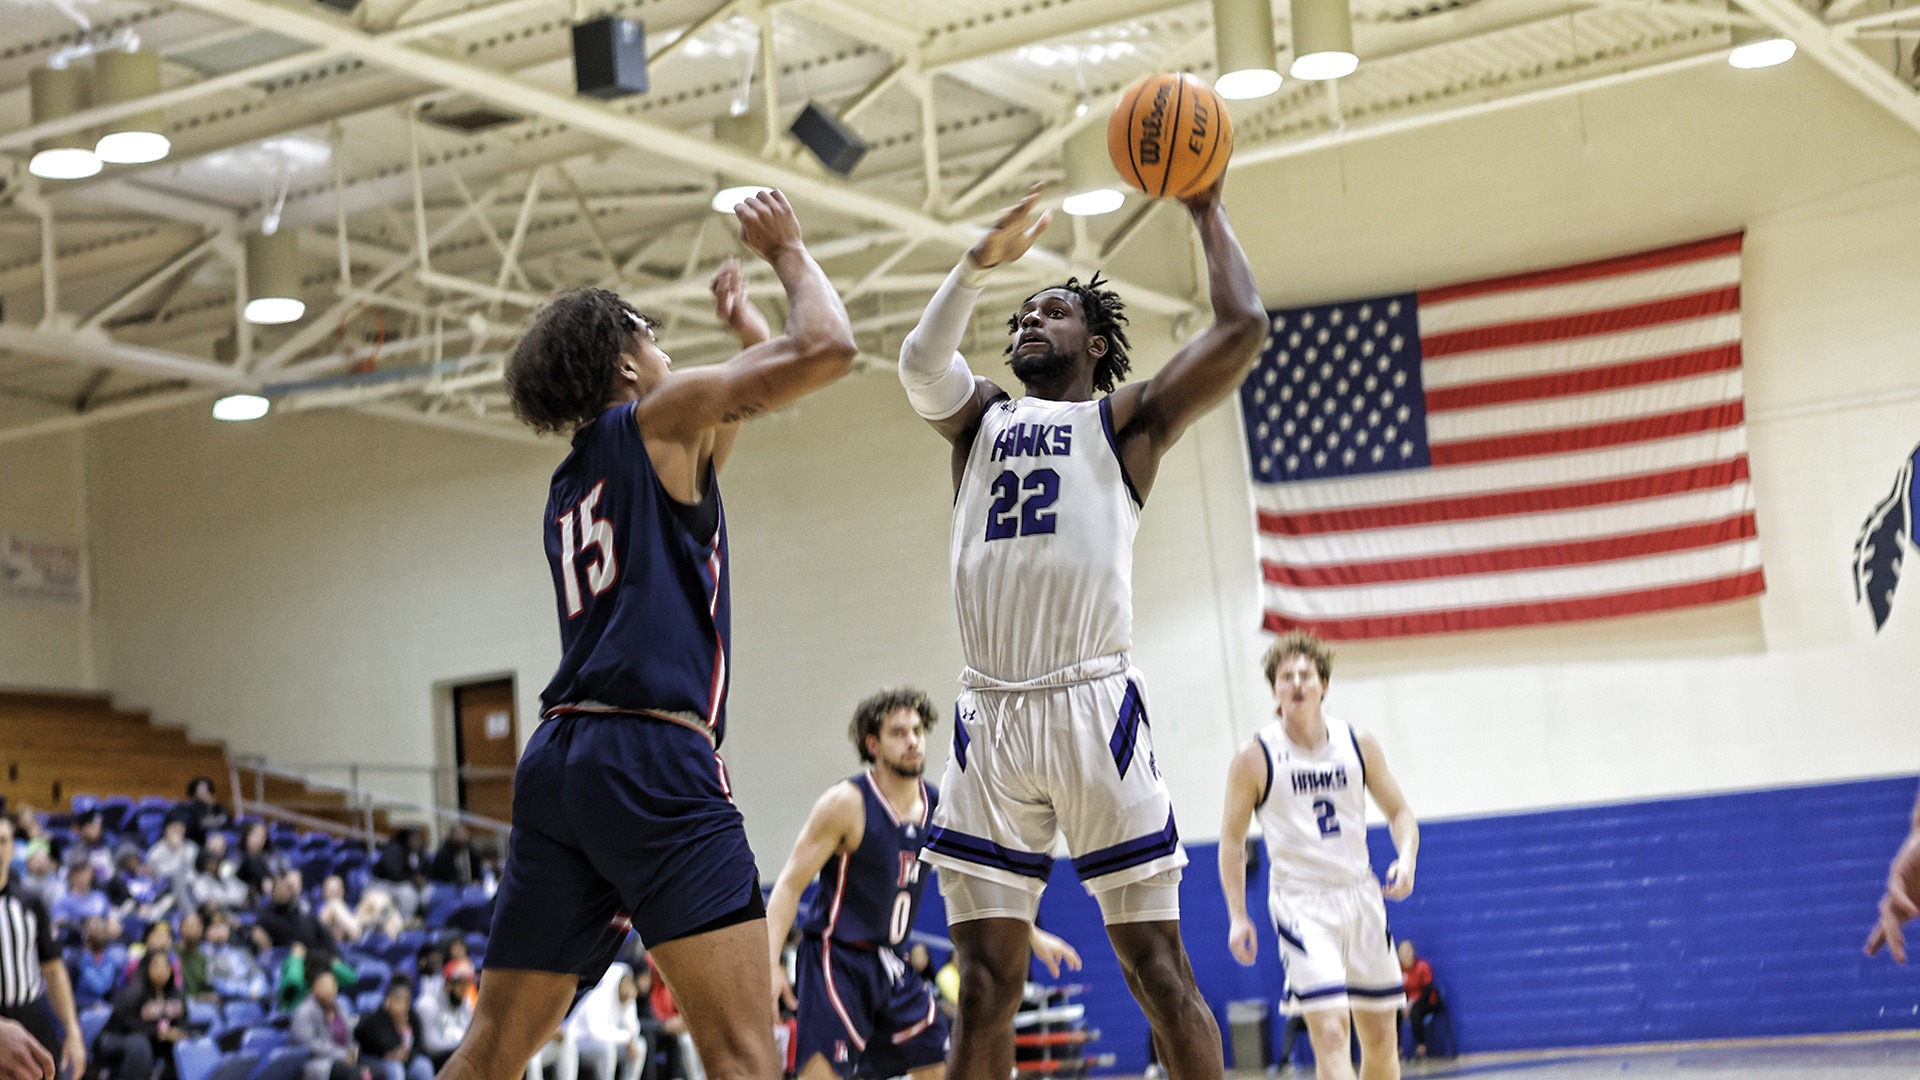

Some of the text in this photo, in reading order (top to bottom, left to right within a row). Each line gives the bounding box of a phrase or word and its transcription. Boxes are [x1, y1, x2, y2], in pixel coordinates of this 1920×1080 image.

[1140, 84, 1173, 166] Wilson
[990, 422, 1073, 462] HAWKS
[985, 468, 1061, 542] 22
[556, 478, 619, 620] 15
[1313, 796, 1342, 839] 2
[889, 889, 912, 945] 0
